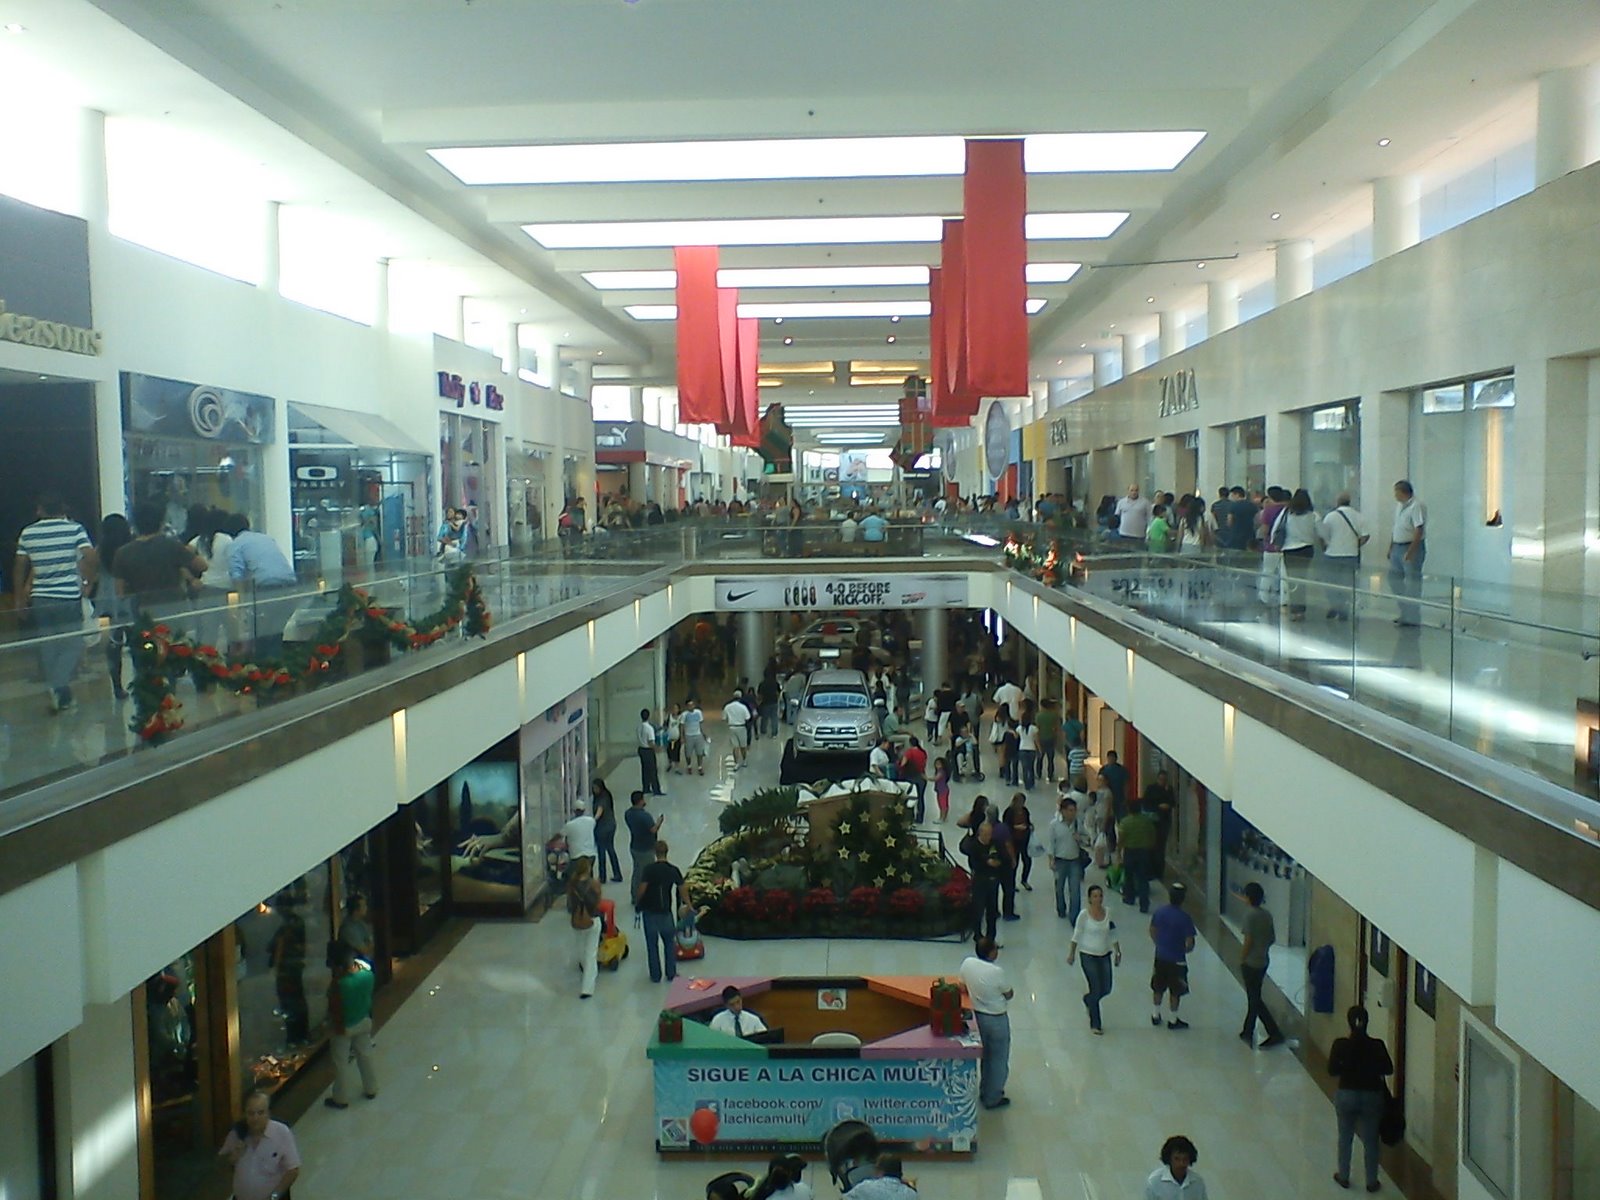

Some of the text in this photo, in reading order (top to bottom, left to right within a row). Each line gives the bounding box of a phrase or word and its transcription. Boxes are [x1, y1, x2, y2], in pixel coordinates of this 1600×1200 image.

[1158, 367, 1200, 418] ZARA
[825, 582, 891, 595] 4-0 BEFORE
[833, 593, 885, 606] KICK-OFF.
[687, 1067, 948, 1082] SIGUE A LA CHICA MULTI
[724, 1098, 824, 1110] facebook.com/
[864, 1097, 945, 1109] twitter.com/
